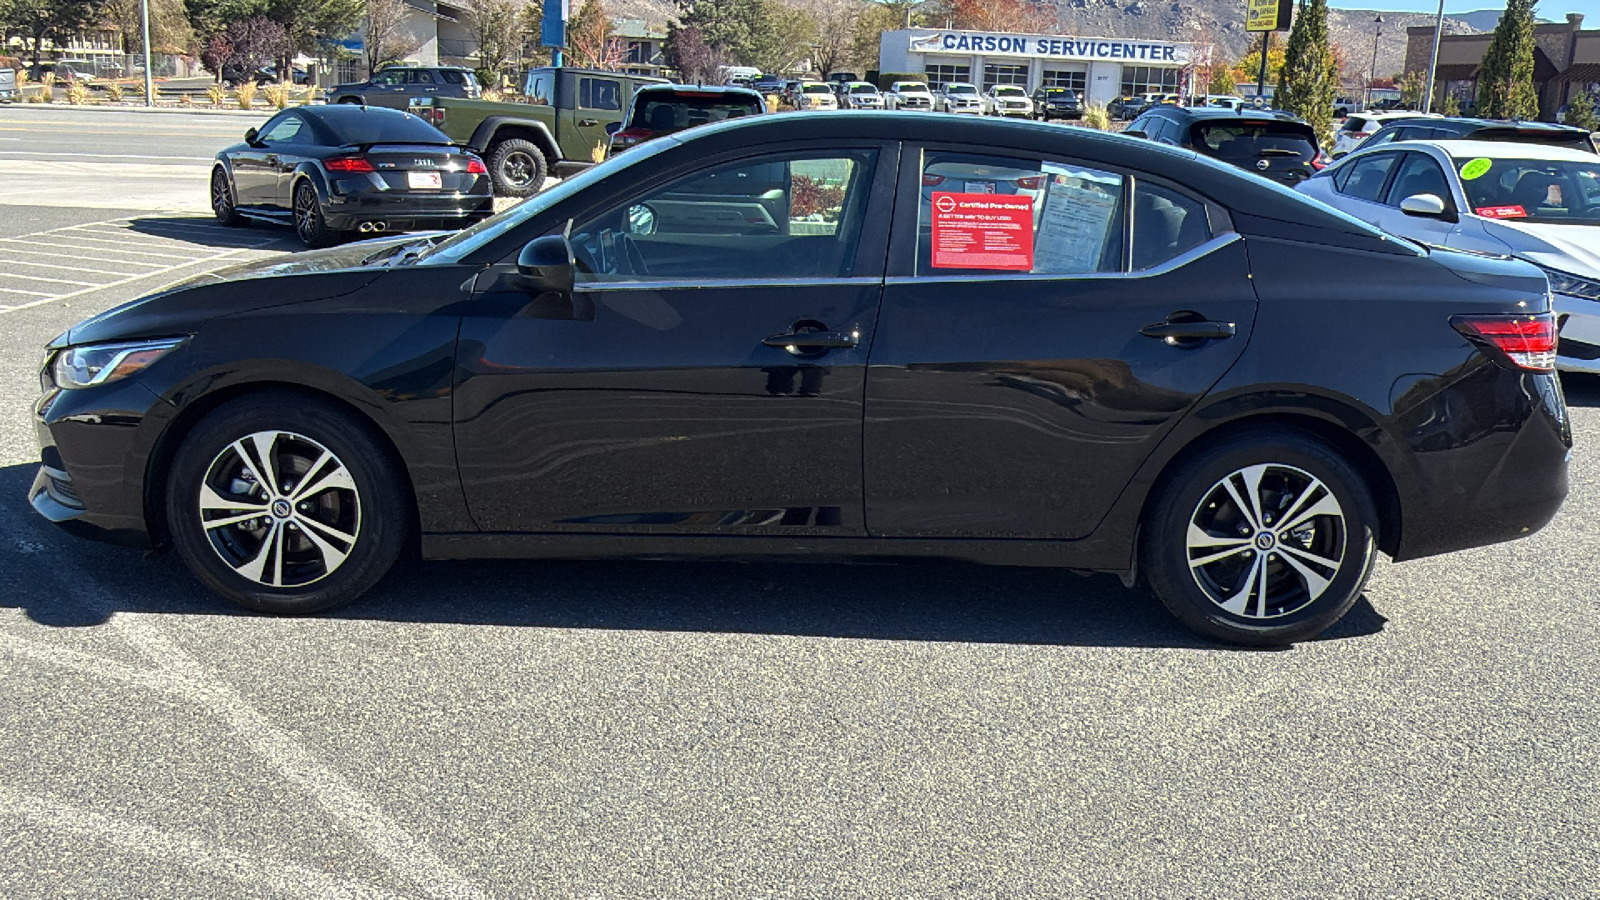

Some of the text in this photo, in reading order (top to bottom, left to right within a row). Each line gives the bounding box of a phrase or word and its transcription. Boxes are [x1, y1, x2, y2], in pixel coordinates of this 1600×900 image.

[943, 34, 1175, 61] CARSON SERVICENTER
[989, 203, 1029, 211] Pre-Owned
